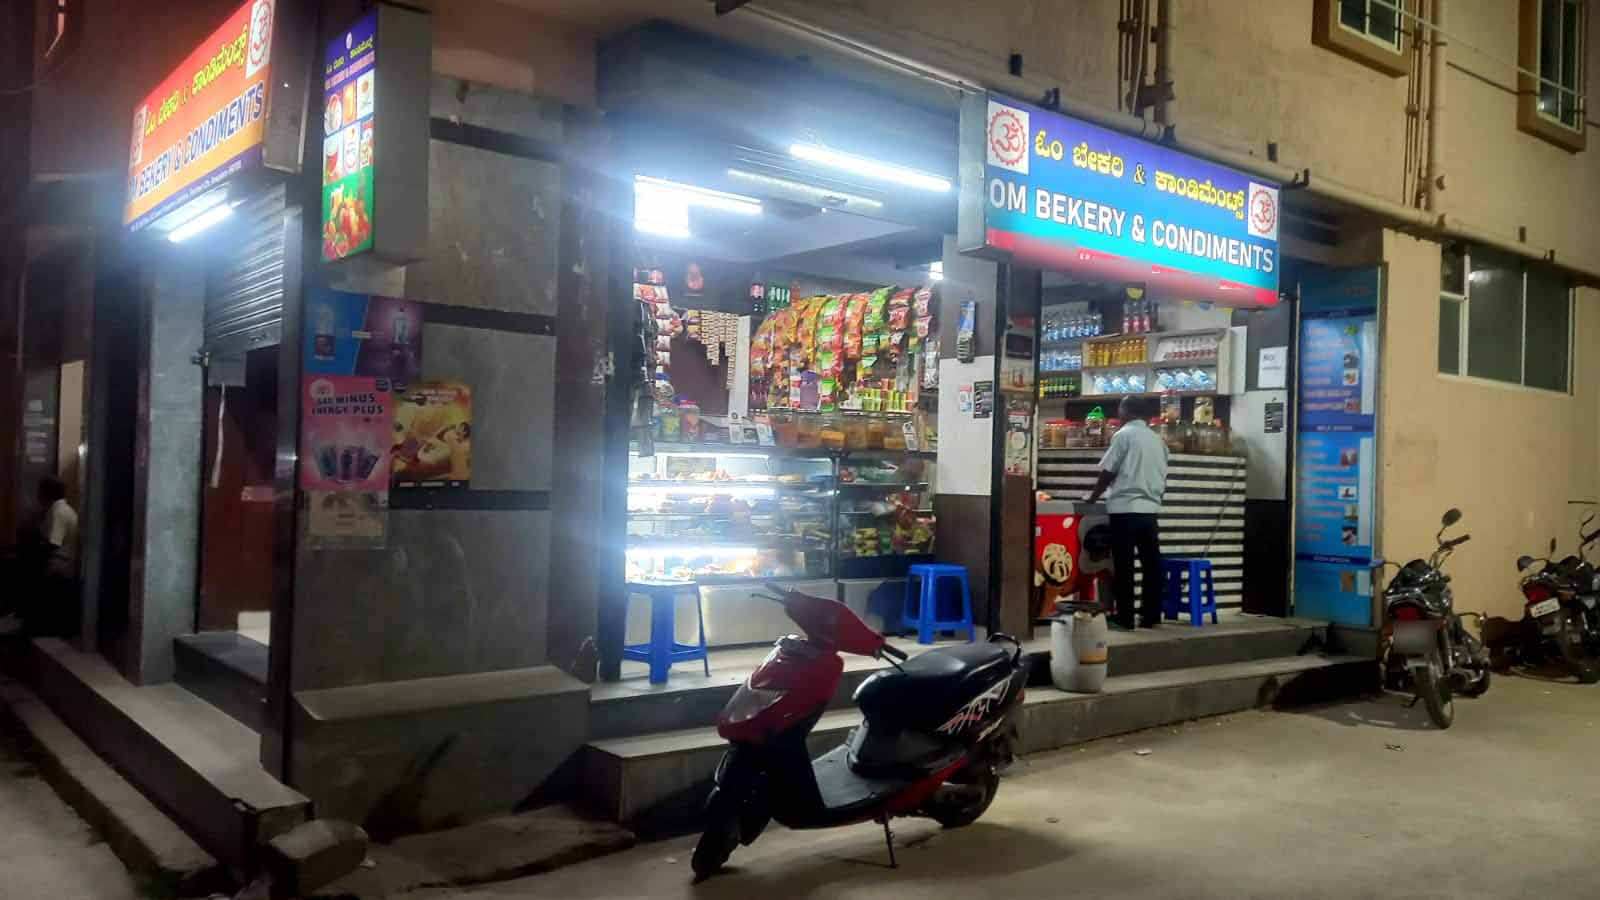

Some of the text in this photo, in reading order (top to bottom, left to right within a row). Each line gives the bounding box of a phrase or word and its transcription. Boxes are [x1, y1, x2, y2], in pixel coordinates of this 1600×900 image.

[183, 79, 264, 165] CONDIMENTS
[1035, 129, 1063, 161] ಓಂ
[1073, 141, 1124, 178] ಬೇಕರಿ
[1133, 163, 1146, 185] &
[990, 178, 1274, 273] OM BEKERY & CONDIMENTS
